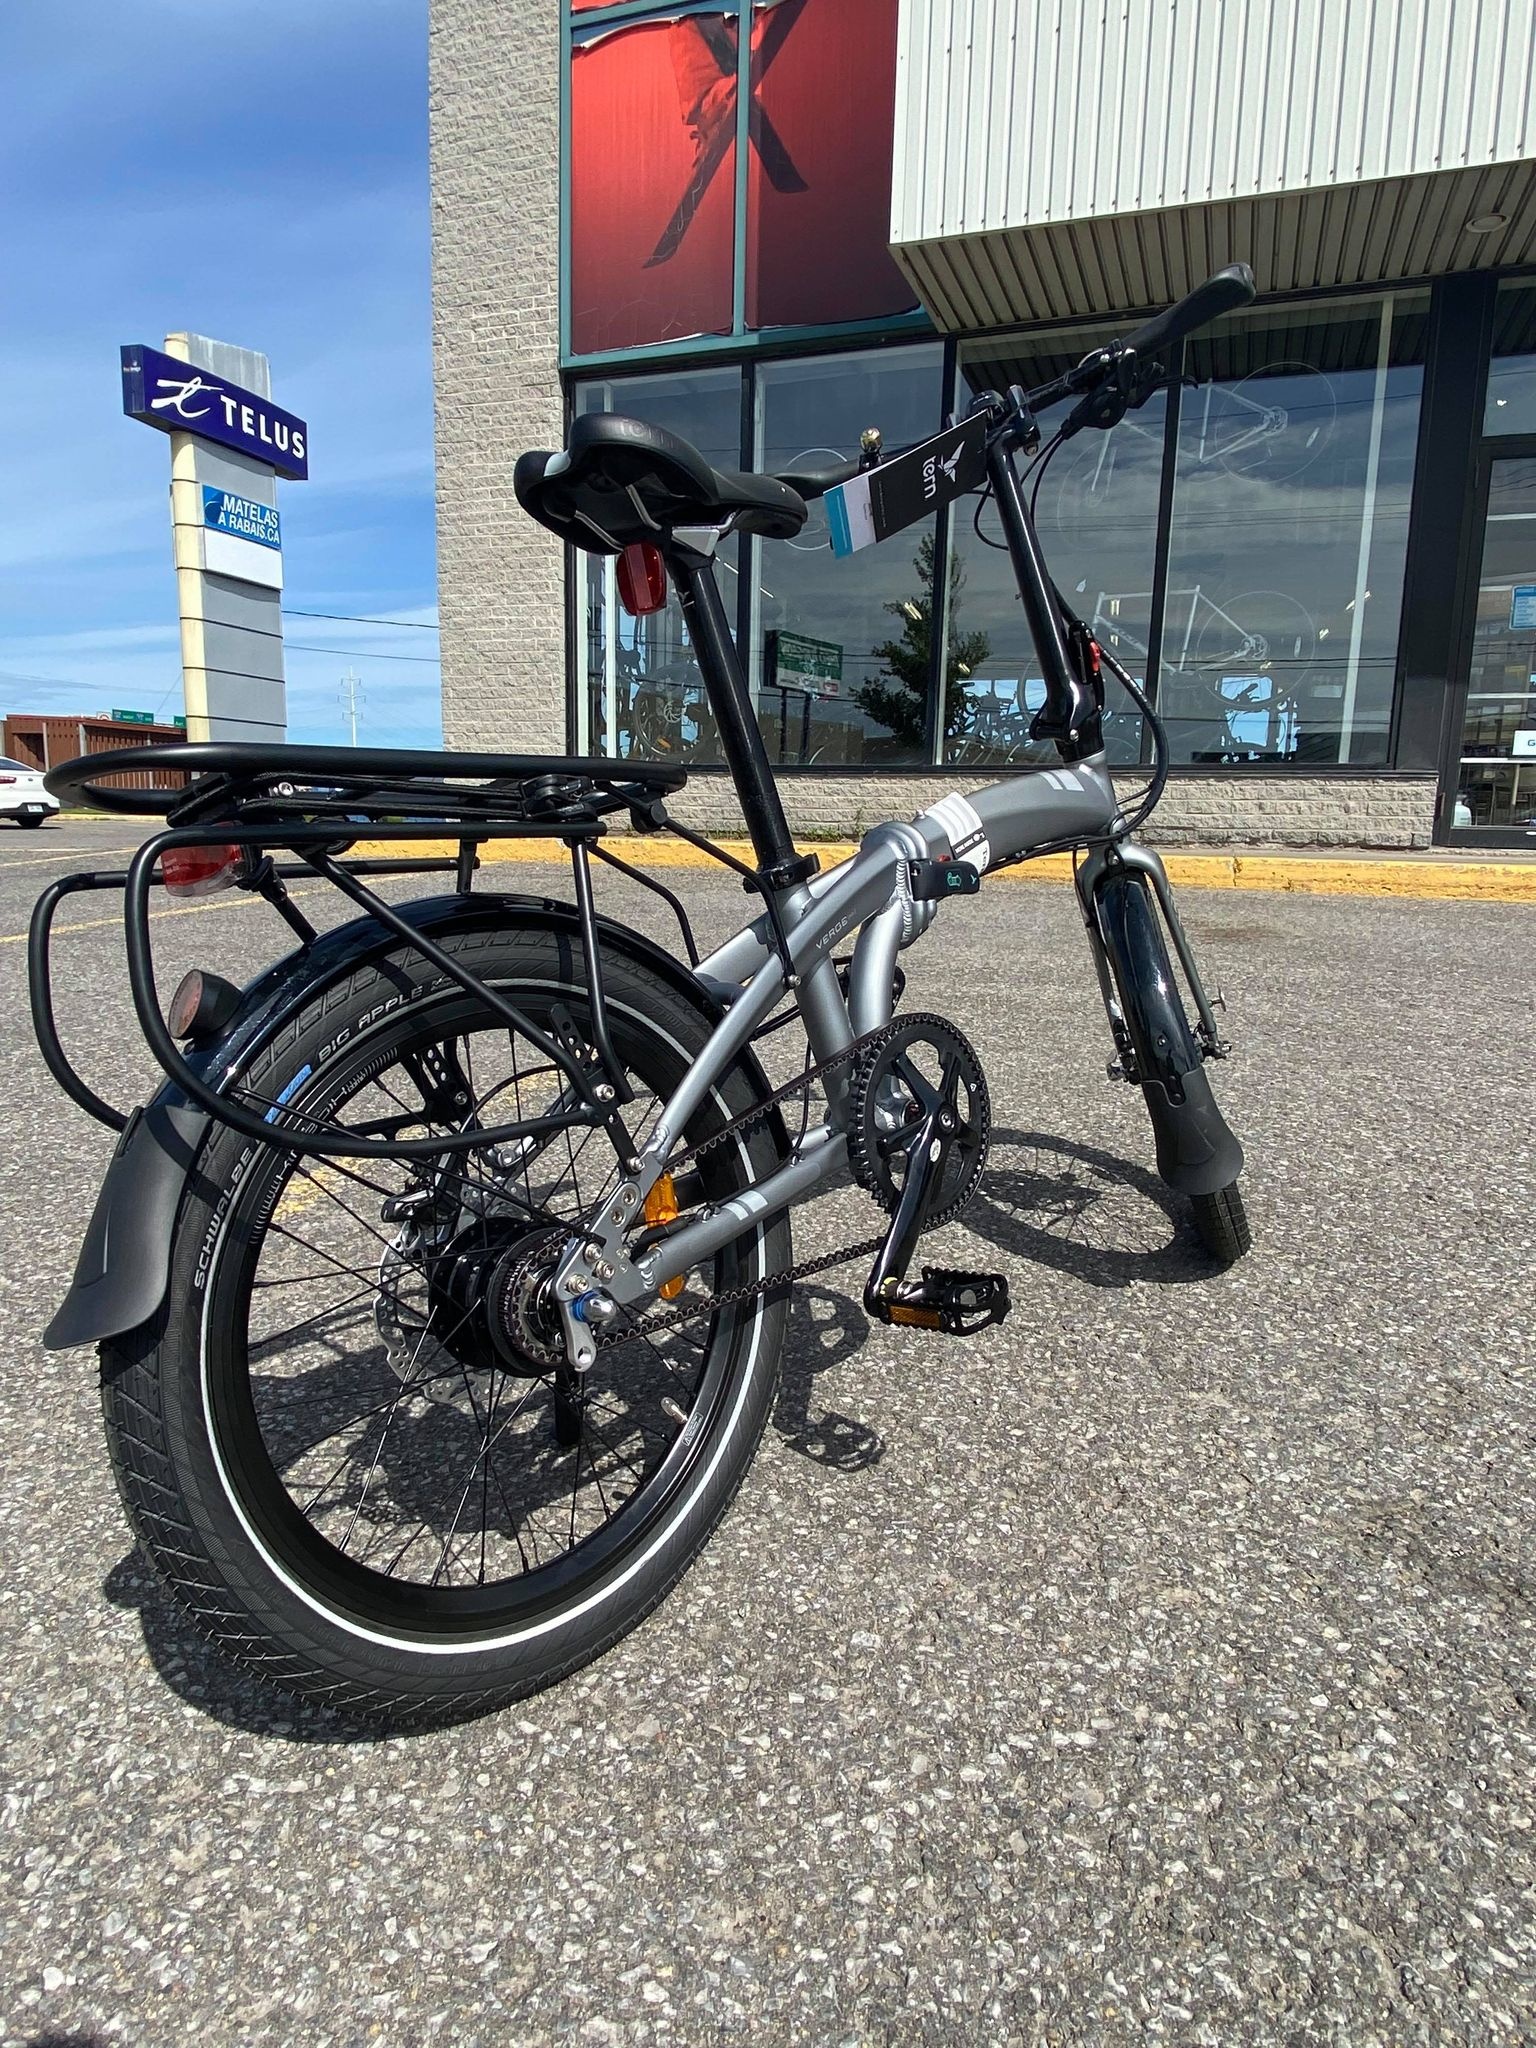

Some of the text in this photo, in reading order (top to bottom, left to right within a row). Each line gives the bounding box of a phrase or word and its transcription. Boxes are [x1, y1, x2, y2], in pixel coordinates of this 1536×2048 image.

[220, 394, 305, 459] TELUS
[922, 455, 937, 499] tern
[224, 494, 278, 529] MATELAS
[228, 517, 280, 544] RABAIS.CA
[815, 915, 848, 950] VERGE
[318, 985, 423, 1063] BIG APPLE
[193, 1147, 252, 1290] SCHWALBE
